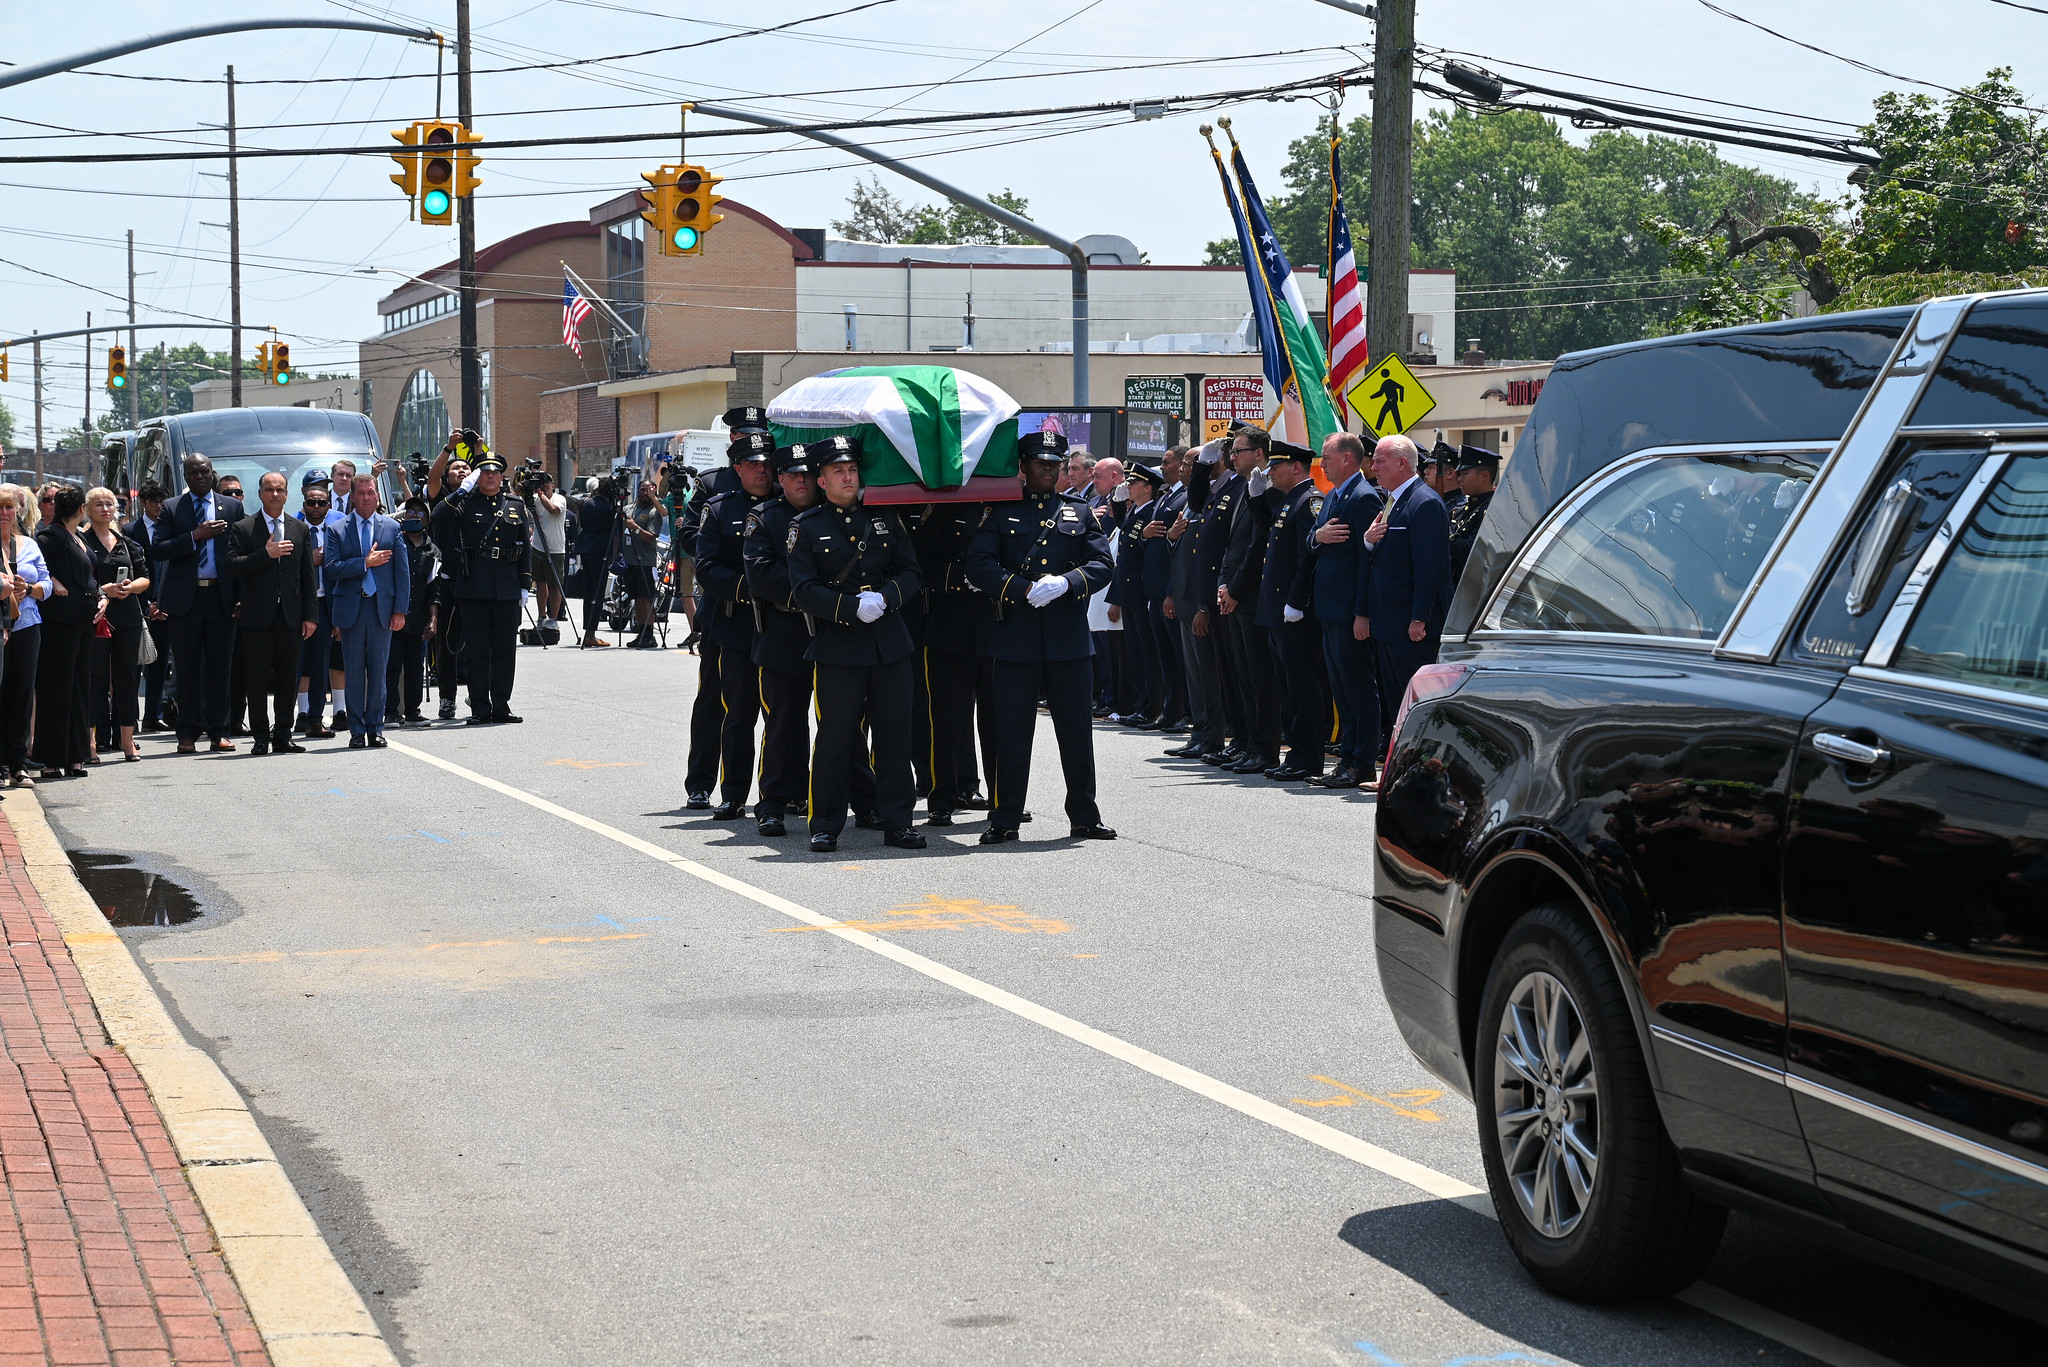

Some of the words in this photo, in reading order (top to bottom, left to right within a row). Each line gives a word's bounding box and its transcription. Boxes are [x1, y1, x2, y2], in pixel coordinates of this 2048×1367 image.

[1128, 379, 1182, 395] REGISTERED
[1207, 380, 1263, 394] REGISTERED
[1507, 380, 1529, 406] AUTO
[1531, 378, 1546, 404] PH
[1127, 401, 1151, 409] MOTOR
[1153, 401, 1183, 409] VEHICLE
[1206, 401, 1232, 410] MOTOR
[1235, 401, 1264, 410] VEHICLE
[1208, 410, 1233, 419] RETAIL
[1236, 410, 1263, 419] DEALER
[1808, 636, 1857, 657] PLATINUM
[1969, 619, 2030, 676] NEW
